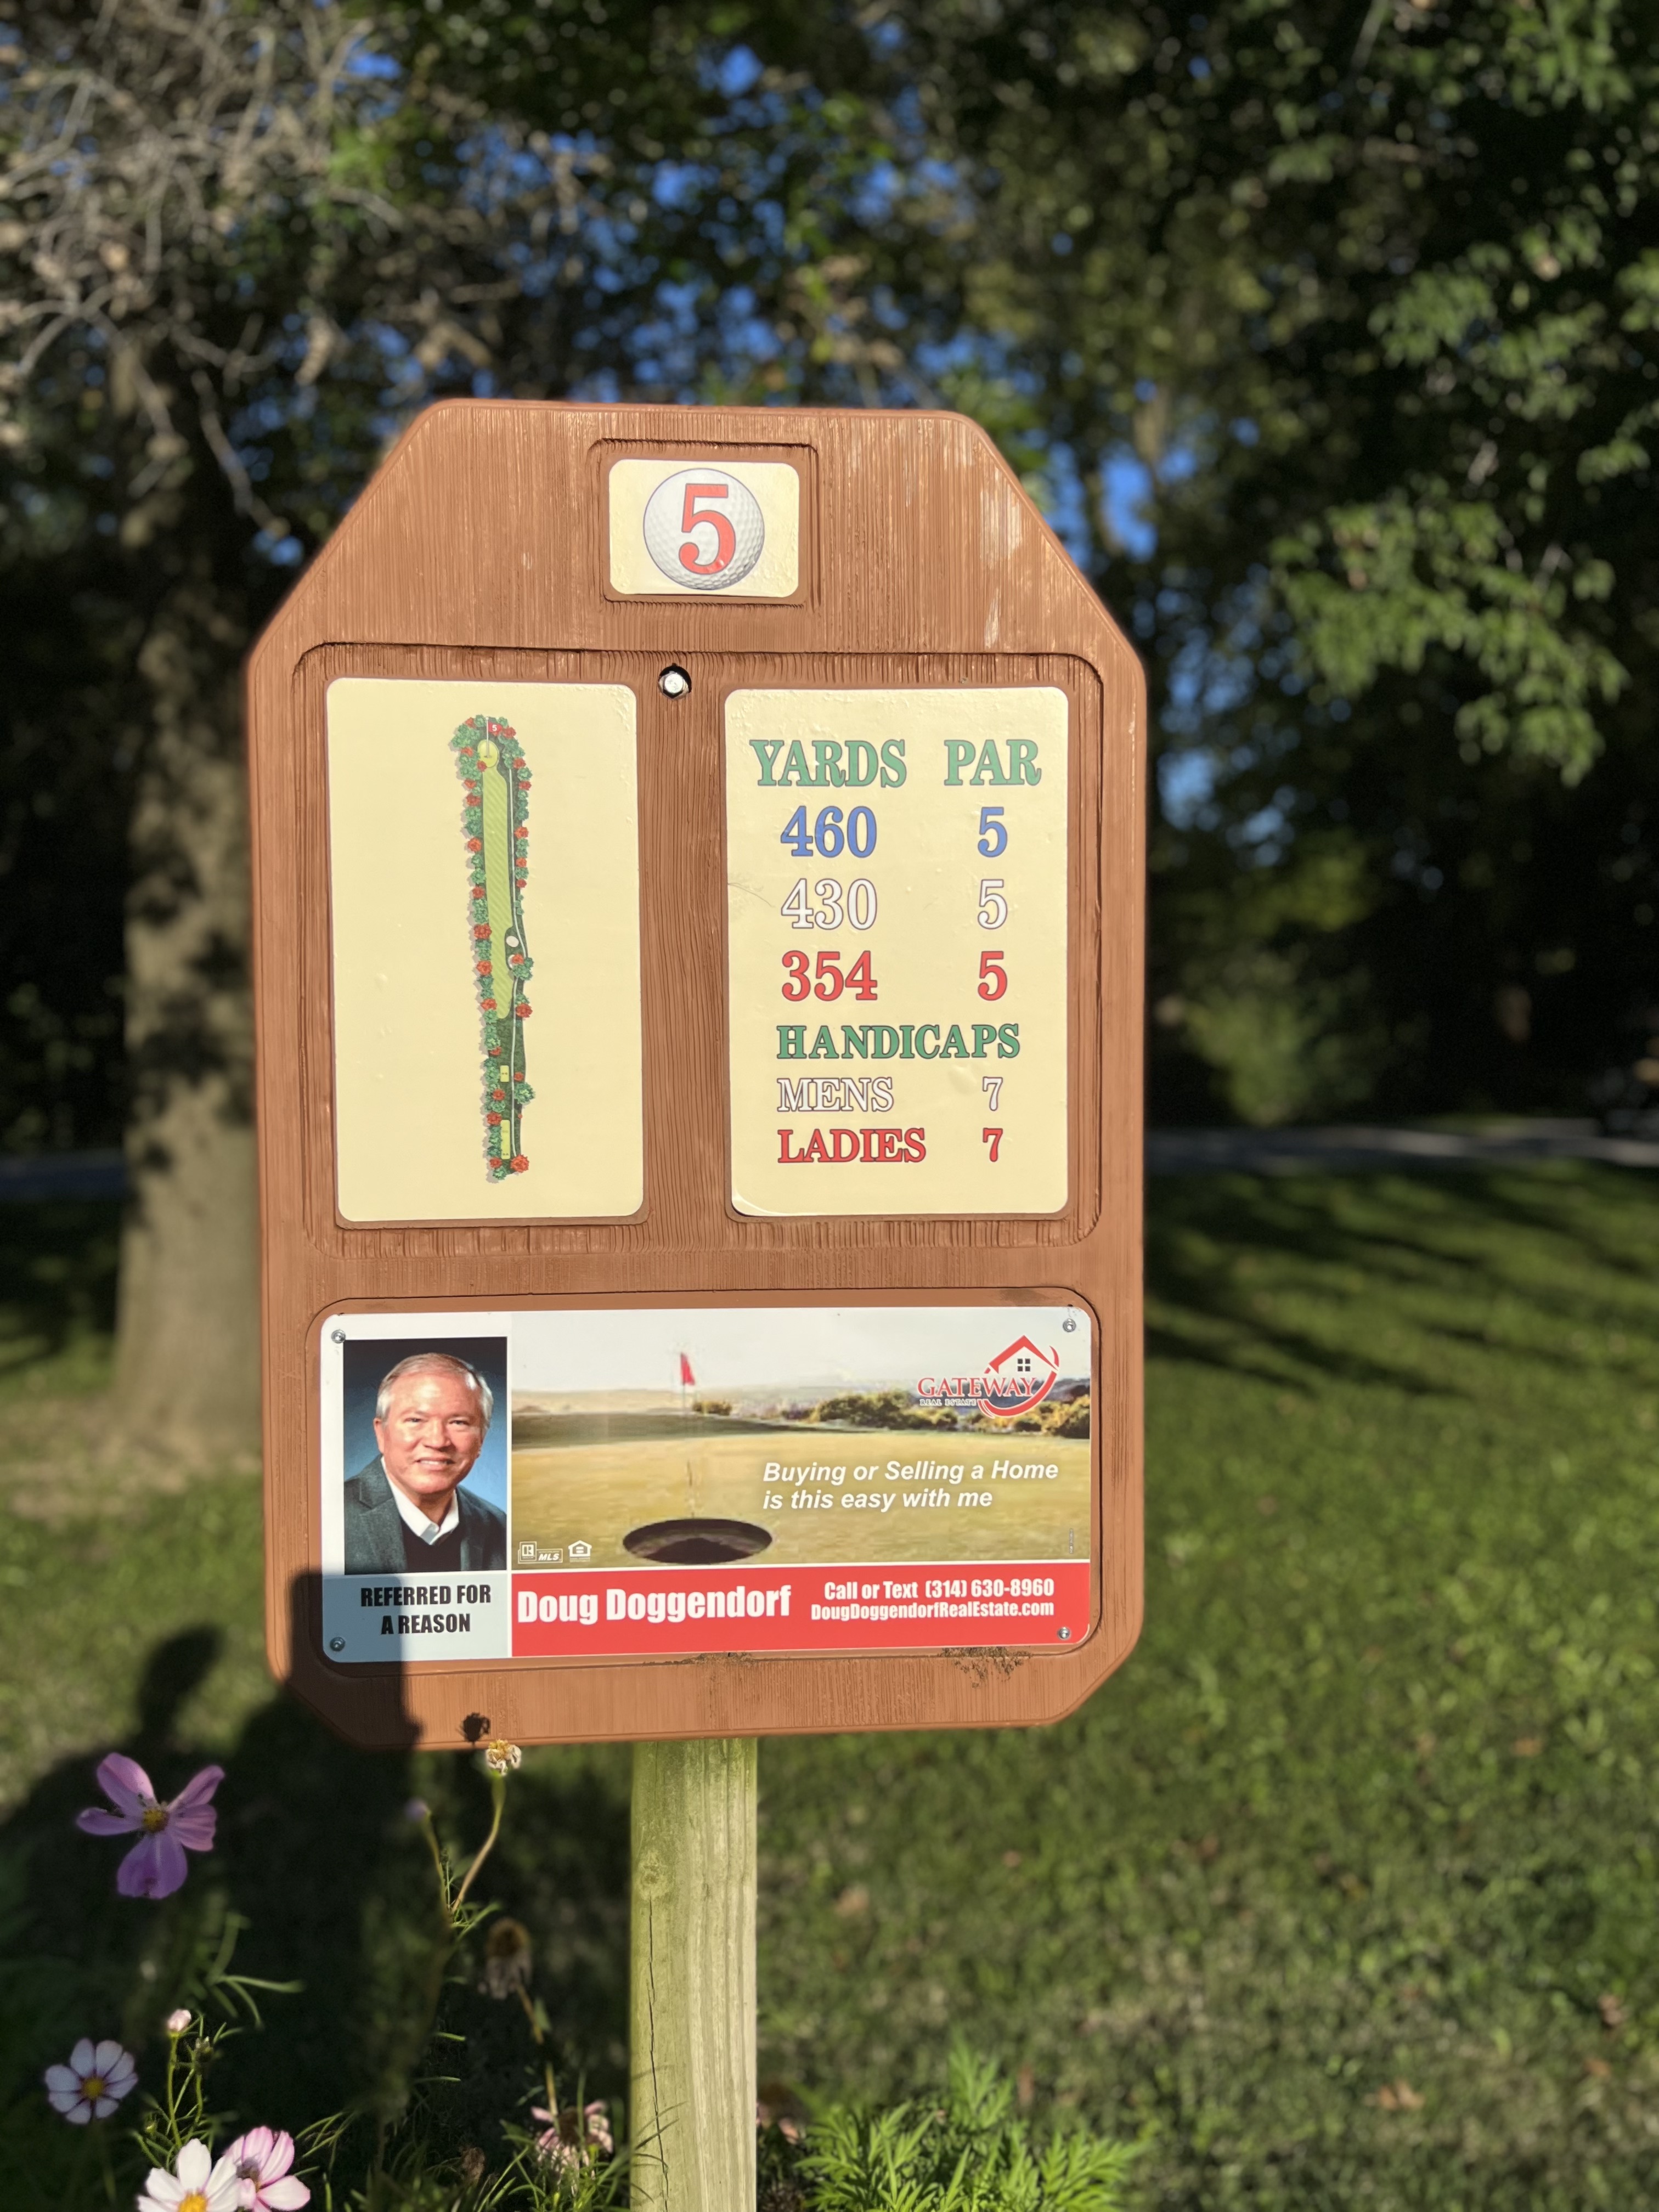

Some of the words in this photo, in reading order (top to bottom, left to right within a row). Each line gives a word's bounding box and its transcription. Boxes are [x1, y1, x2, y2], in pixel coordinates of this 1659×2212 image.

[679, 483, 736, 575] 5
[750, 738, 907, 788] YARDS
[944, 738, 1042, 786] PAR
[781, 806, 877, 857] 460
[977, 806, 1008, 857] 5
[781, 878, 877, 930] 430
[977, 878, 1008, 930] 5
[781, 950, 878, 1001] 354
[977, 950, 1008, 1001] 5
[776, 1023, 1020, 1059] HANDICAPS
[776, 1076, 894, 1112] MENS
[981, 1077, 1003, 1111] 7
[777, 1127, 926, 1163] LADIES
[982, 1128, 1003, 1161] 7
[917, 1377, 1036, 1397] GATEWAY
[763, 1462, 845, 1486] Buying
[853, 1465, 879, 1481] or
[884, 1460, 964, 1484] Selling
[971, 1465, 983, 1480] a
[991, 1460, 1058, 1480] Home
[763, 1491, 783, 1509] is
[791, 1490, 833, 1509] this
[841, 1492, 896, 1513] easy
[902, 1488, 950, 1507] with
[957, 1491, 992, 1506] me
[538, 1553, 560, 1561] MLS
[360, 1585, 451, 1607] REFERRED
[456, 1584, 491, 1604] FOR
[517, 1590, 598, 1625] Doug
[606, 1585, 791, 1623] Doggendorf
[824, 1581, 857, 1600] Call
[861, 1584, 879, 1599] or
[883, 1581, 918, 1599] Text
[925, 1579, 967, 1598] (314)
[970, 1578, 1054, 1598] 630-8960
[381, 1615, 394, 1635] A
[398, 1613, 471, 1634] REASON
[811, 1601, 1054, 1621] DougDoggendorfRealEstate.com
